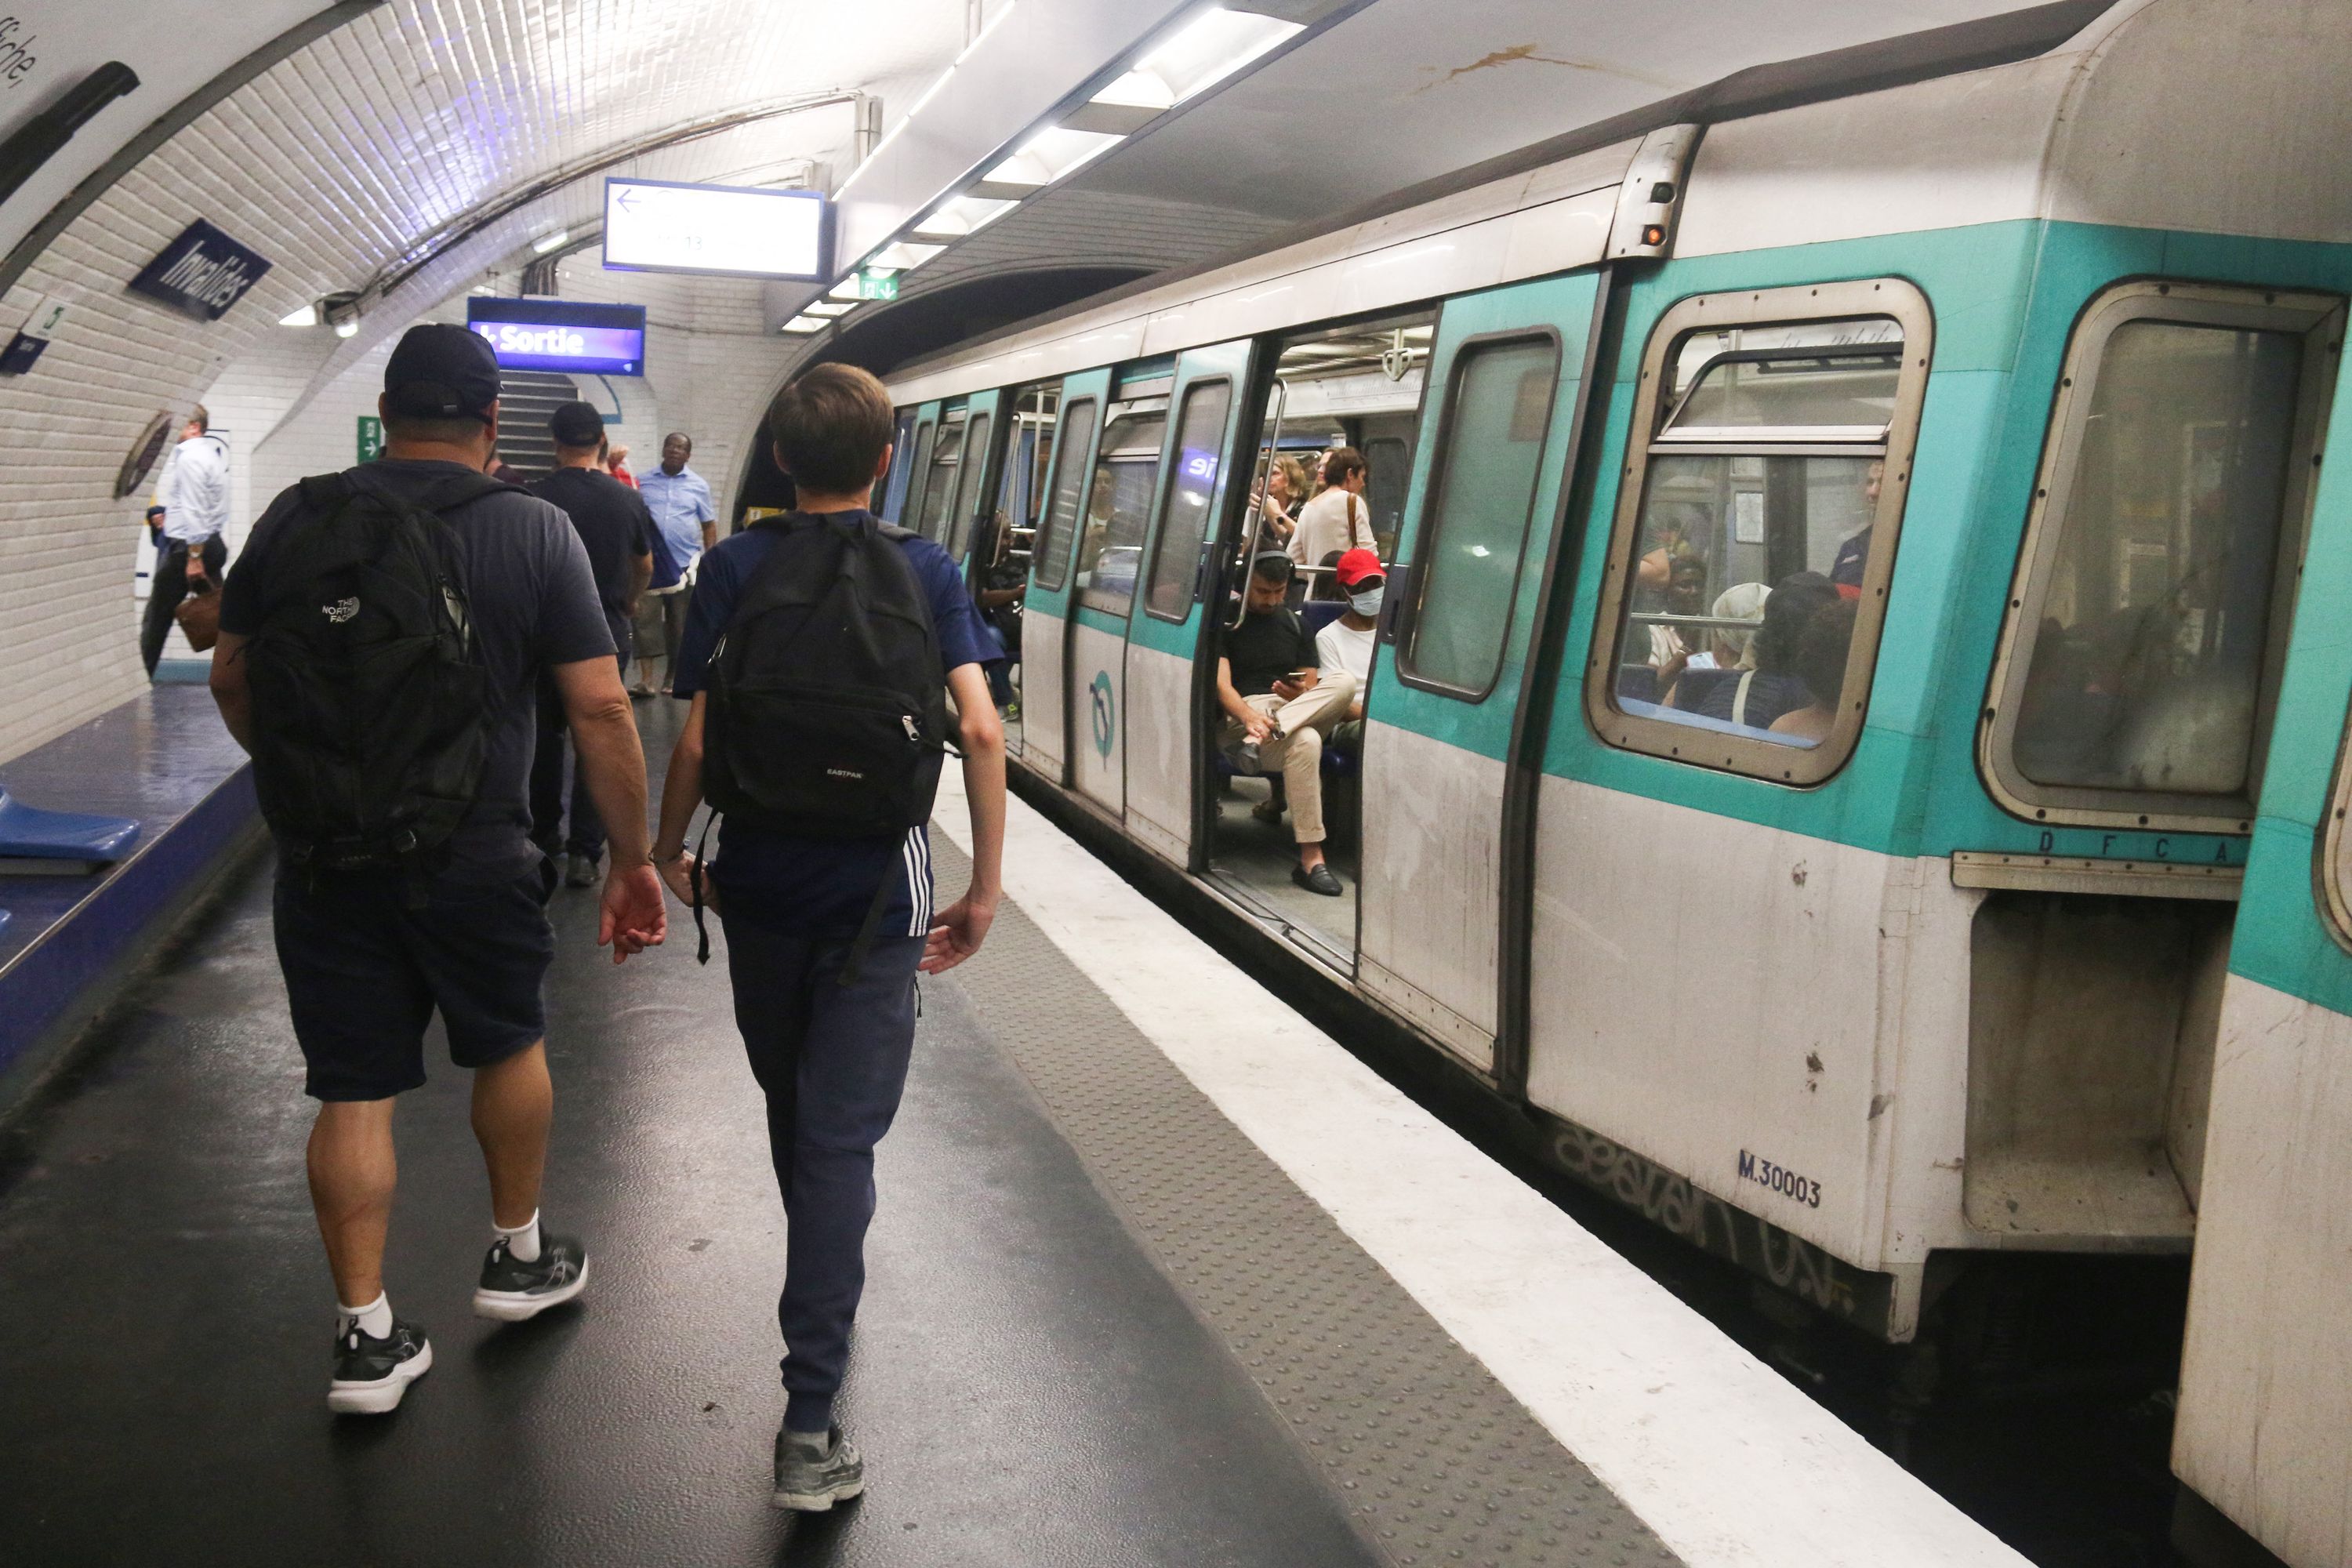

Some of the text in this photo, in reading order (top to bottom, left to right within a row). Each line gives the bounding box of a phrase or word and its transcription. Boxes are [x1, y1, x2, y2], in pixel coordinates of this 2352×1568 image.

[684, 235, 703, 251] 13
[159, 240, 249, 307] Invalides
[499, 325, 584, 354] Sortie
[827, 768, 862, 779] EASTPAK
[2039, 831, 2227, 862] D F C A
[1739, 1149, 1821, 1209] M.30003
